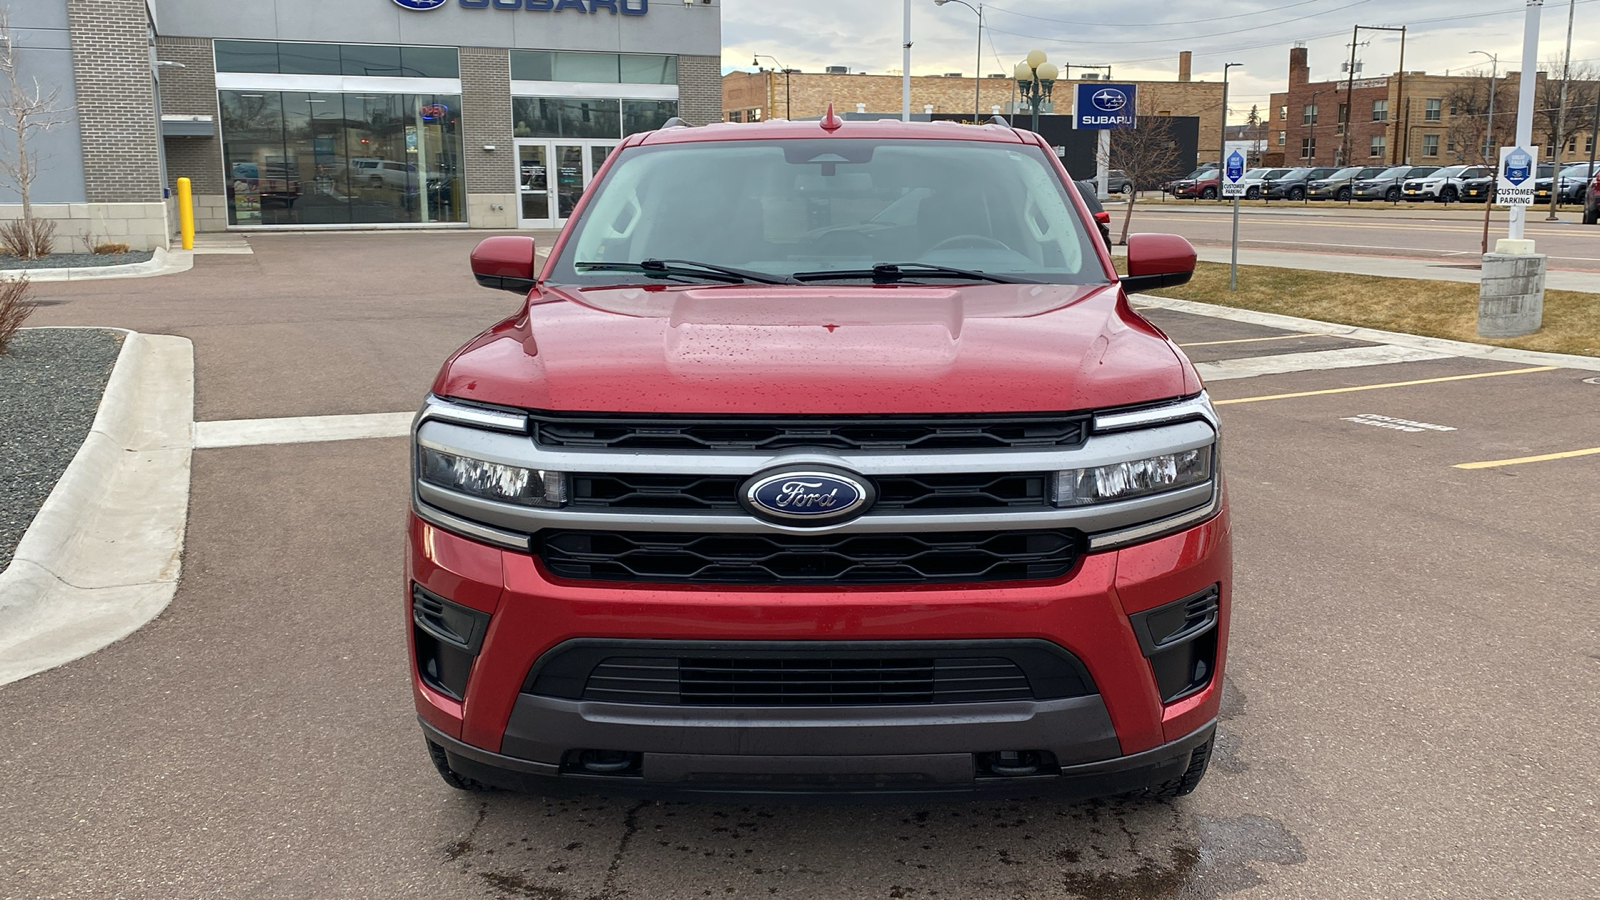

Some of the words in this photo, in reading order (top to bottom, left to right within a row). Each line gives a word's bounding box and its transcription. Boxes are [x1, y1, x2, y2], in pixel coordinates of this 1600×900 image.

[1082, 115, 1132, 125] SUBARU
[1497, 188, 1535, 196] CUSTOMER
[776, 481, 838, 507] Ford
